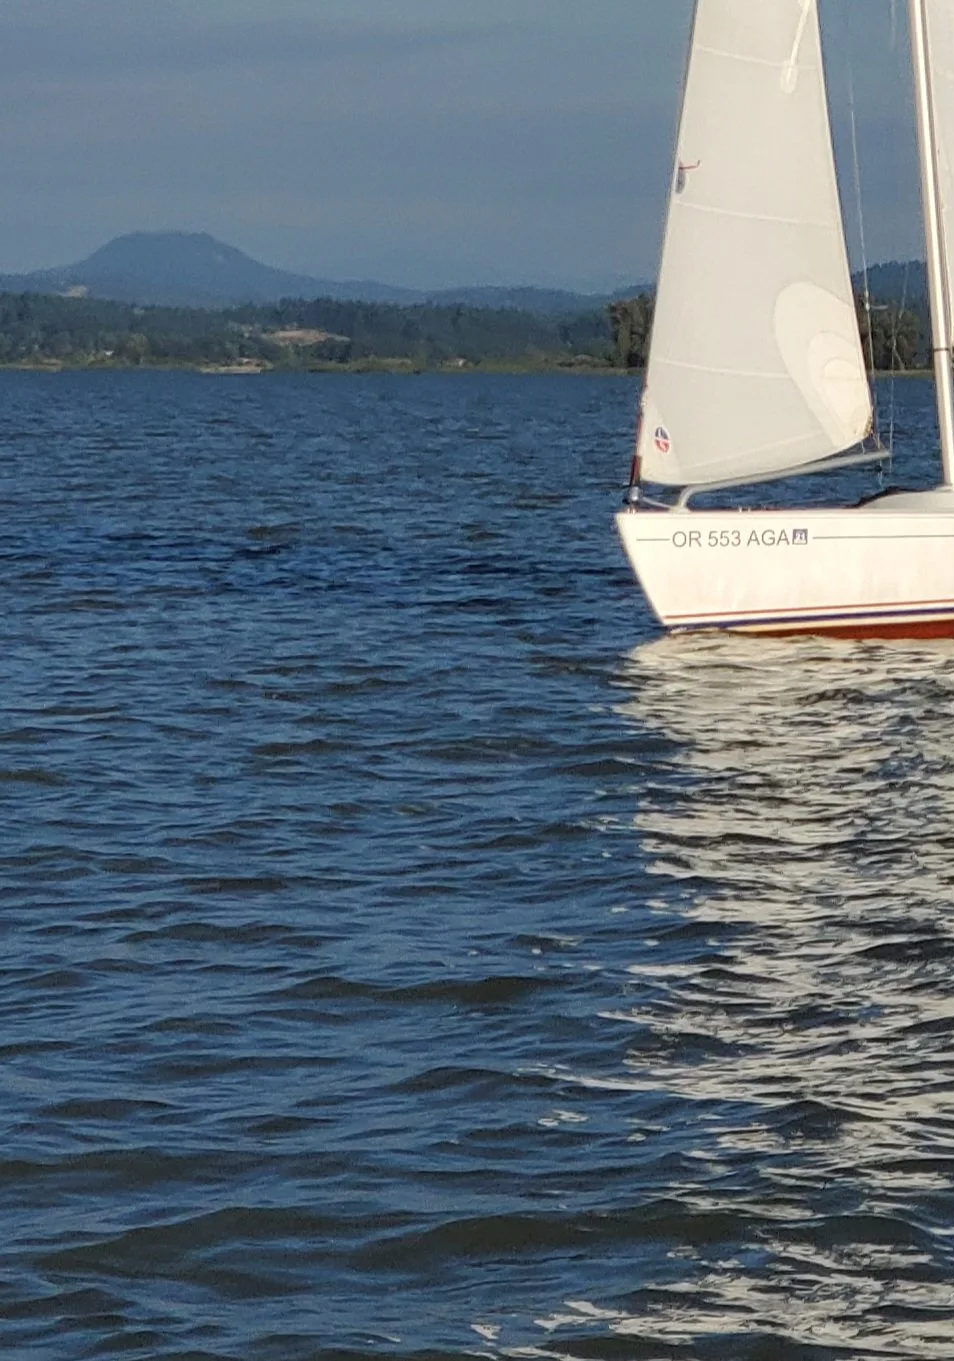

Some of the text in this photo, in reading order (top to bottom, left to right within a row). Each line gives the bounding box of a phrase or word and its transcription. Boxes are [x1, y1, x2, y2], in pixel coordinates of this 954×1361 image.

[672, 529, 790, 548] OR 553 AGA
